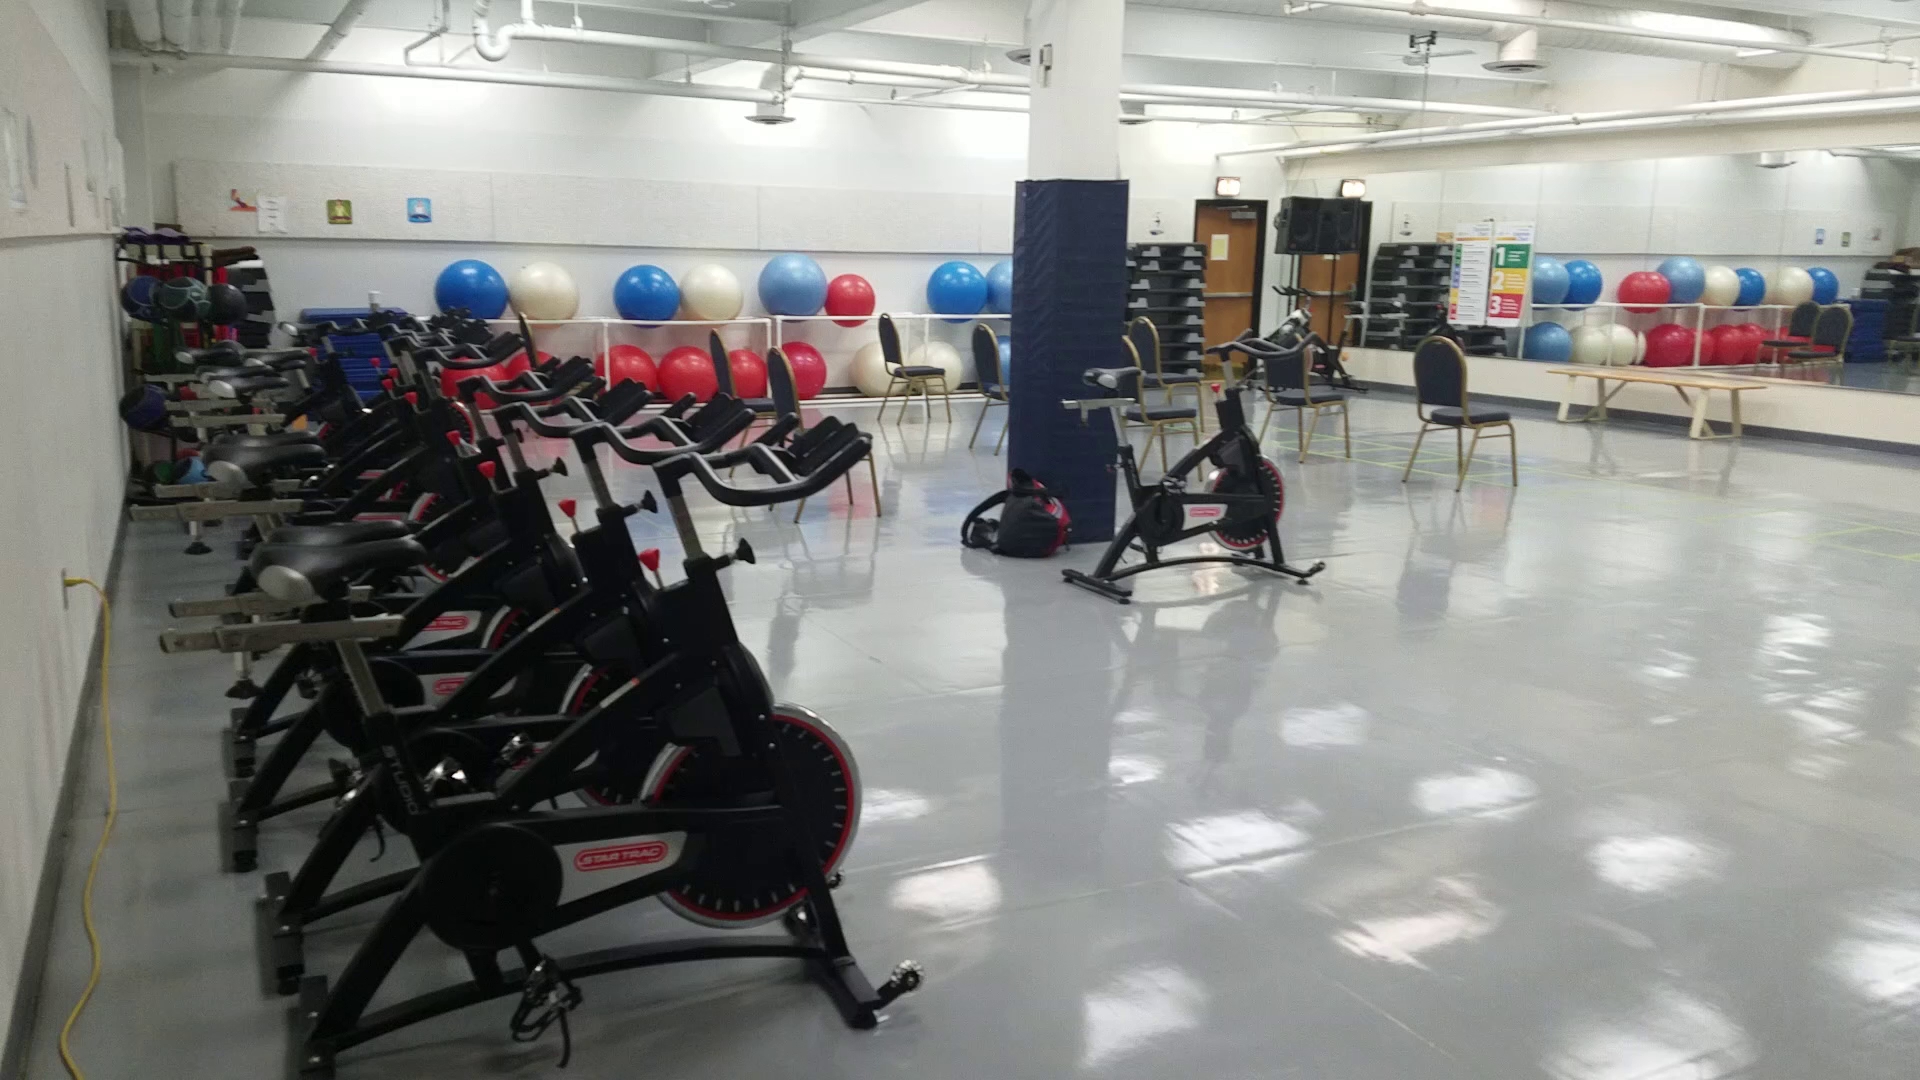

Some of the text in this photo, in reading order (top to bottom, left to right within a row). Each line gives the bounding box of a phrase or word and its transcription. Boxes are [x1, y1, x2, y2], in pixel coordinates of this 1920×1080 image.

[1496, 247, 1505, 265] 1
[1492, 271, 1504, 290] 2
[1489, 296, 1501, 314] 3
[381, 745, 419, 817] STUDIO
[582, 847, 661, 865] STAR TRAC
